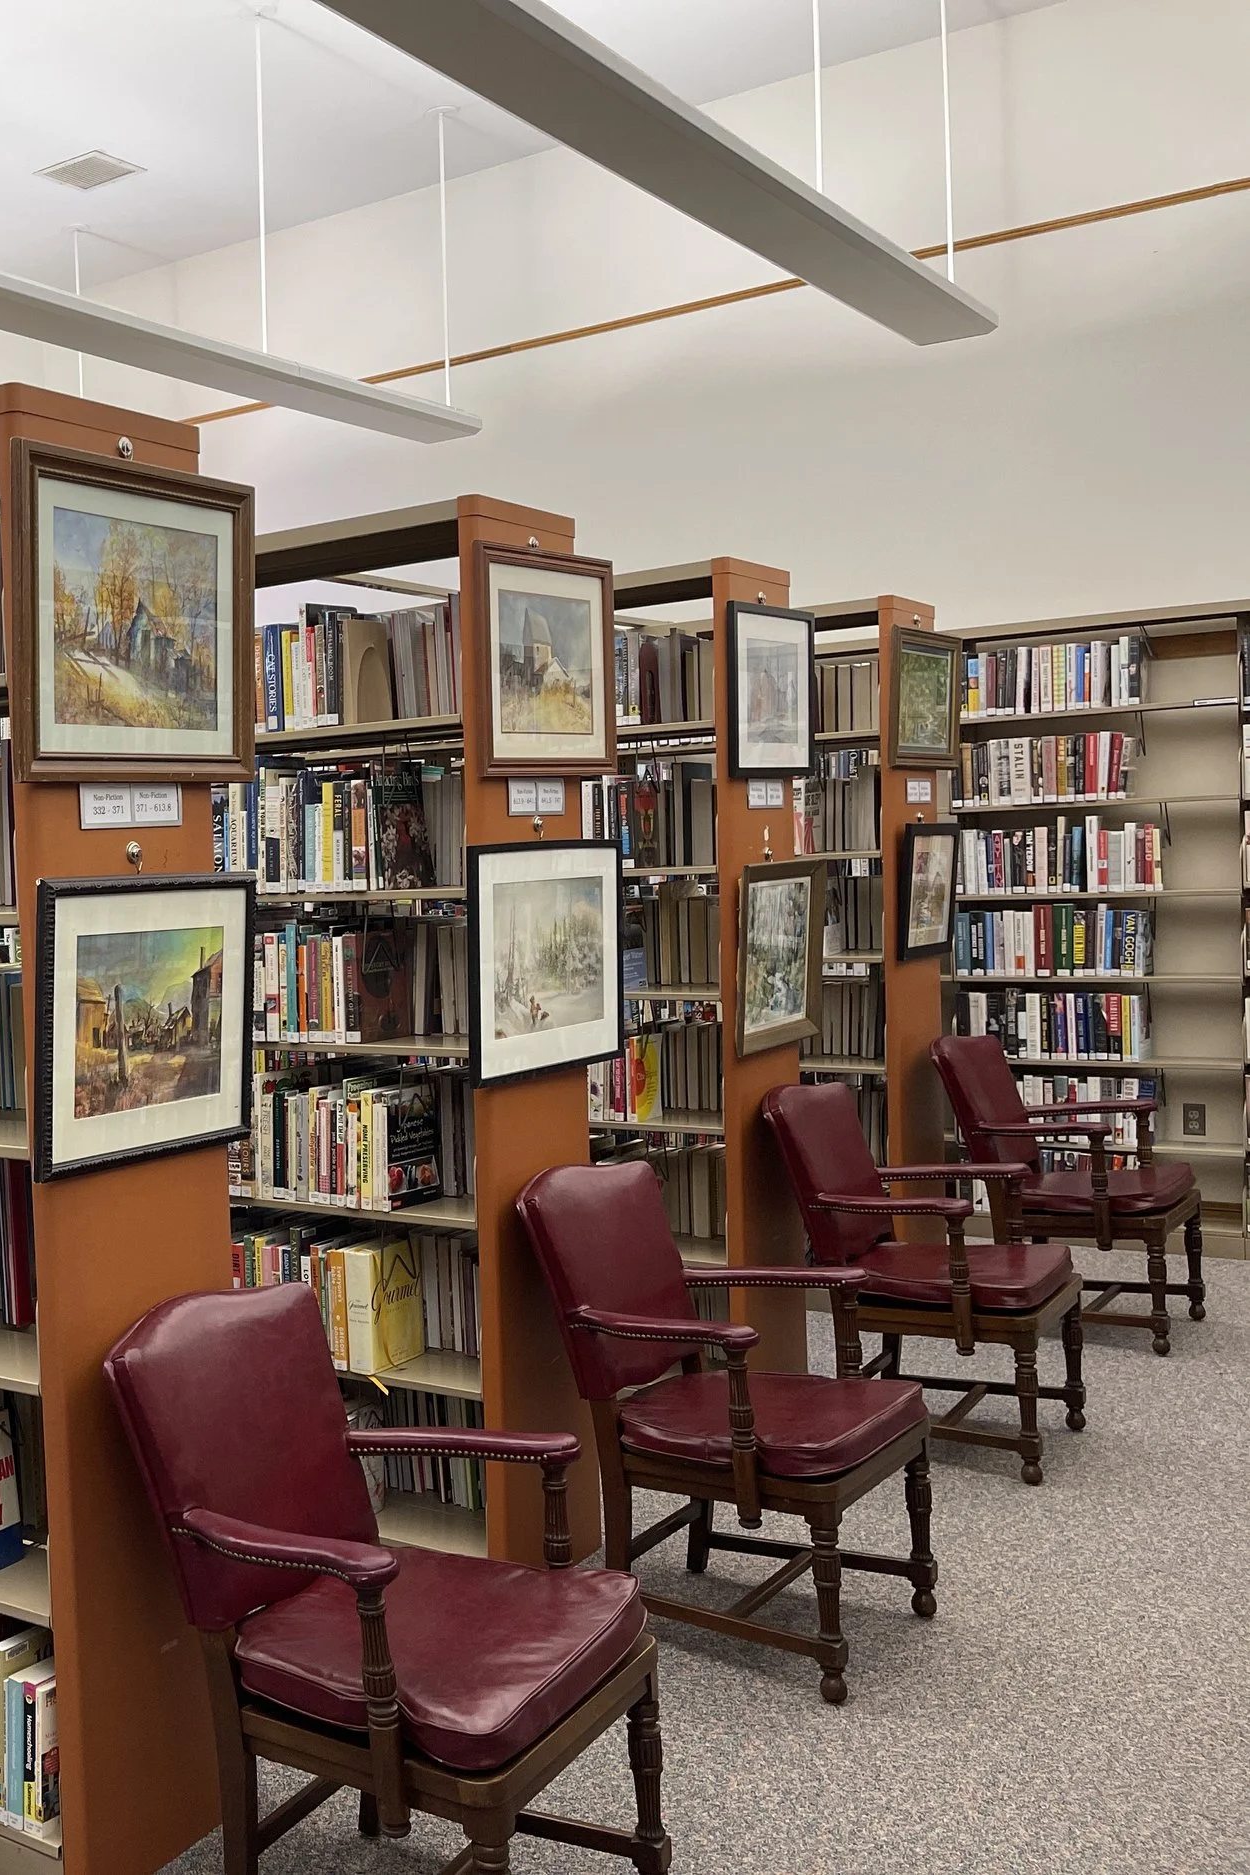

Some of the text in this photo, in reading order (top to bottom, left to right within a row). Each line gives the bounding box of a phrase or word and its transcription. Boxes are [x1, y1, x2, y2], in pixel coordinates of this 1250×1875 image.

[267, 654, 277, 713] CAT STORIES
[1014, 743, 1025, 780] STALIN
[403, 771, 420, 787] Birds
[136, 803, 148, 812] 371
[139, 791, 167, 799] Non-Fiction
[334, 794, 342, 819] FERAL
[93, 805, 124, 815] 332 371
[213, 814, 223, 872] SALMON
[1025, 831, 1034, 872] TIM TEBOW
[1145, 829, 1153, 861] TREJO
[1125, 914, 1135, 964] VAN GOGH
[348, 1003, 354, 1011] OF
[232, 1253, 240, 1273] DIRT
[348, 1299, 369, 1312] Gourmet
[371, 1270, 422, 1325] Gourmet
[25, 1714, 34, 1772] Homeschooling
